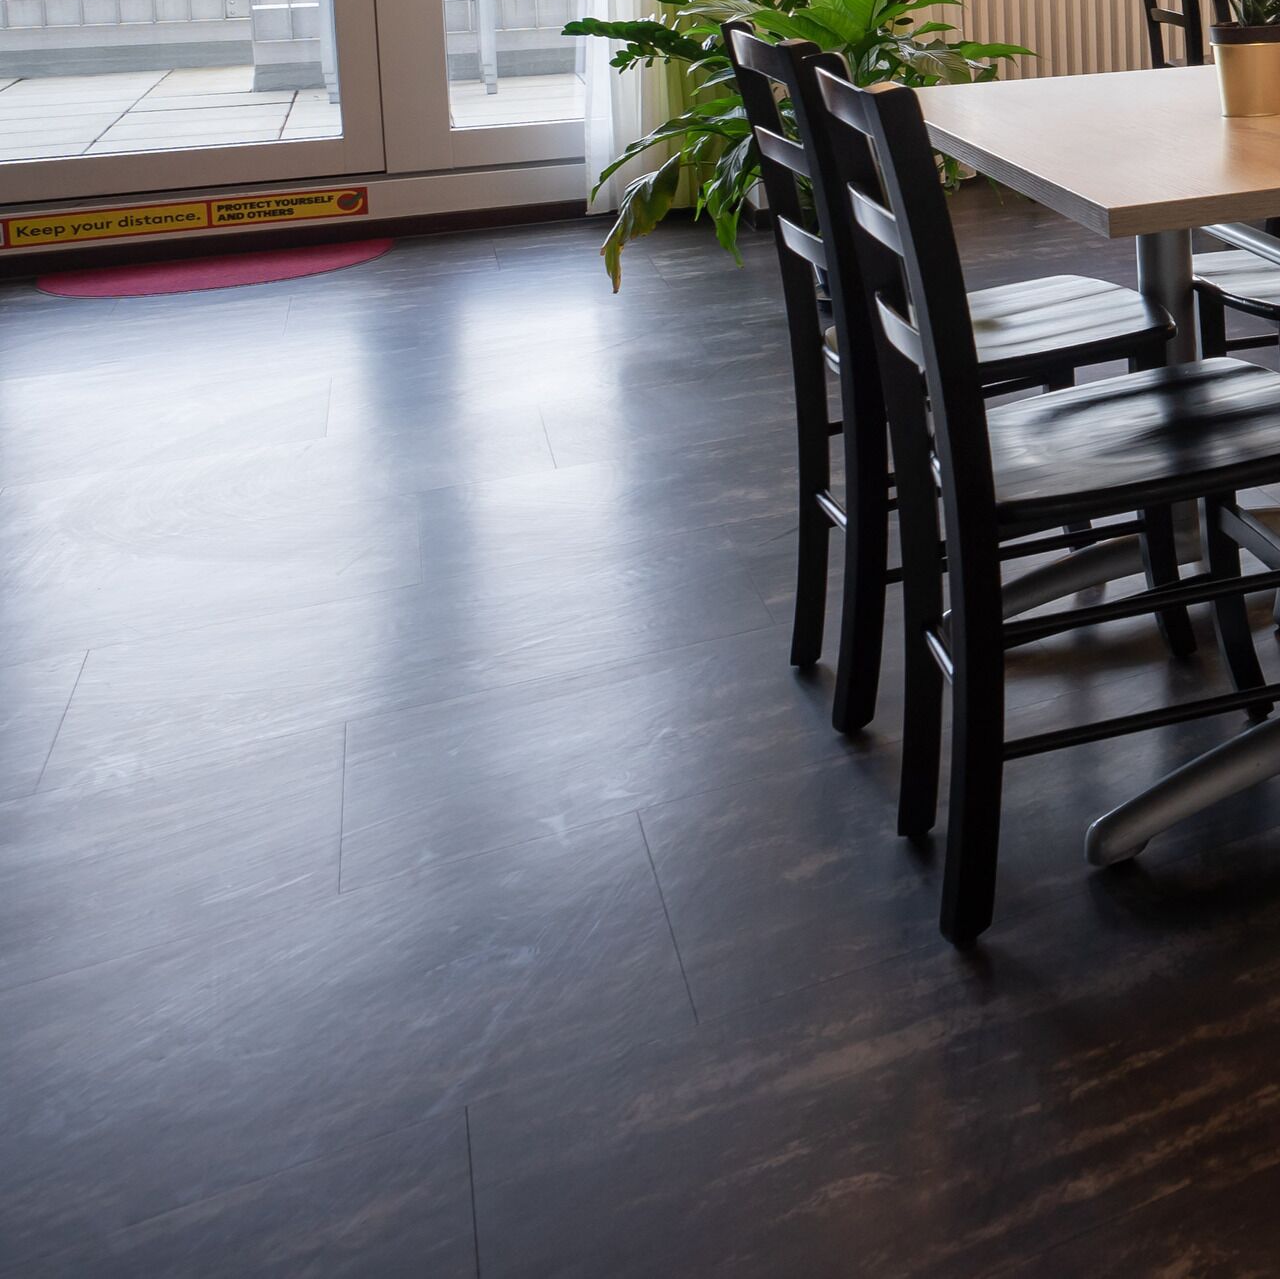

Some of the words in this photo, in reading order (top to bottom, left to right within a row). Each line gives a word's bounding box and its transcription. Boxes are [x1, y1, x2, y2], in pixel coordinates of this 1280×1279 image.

[217, 200, 272, 212] PROTECT
[275, 195, 334, 207] YOURSELF
[217, 212, 244, 222] AND
[246, 208, 294, 219] OTHERS
[16, 224, 65, 238] Keep
[71, 220, 112, 236] your
[118, 212, 201, 228] distance.
